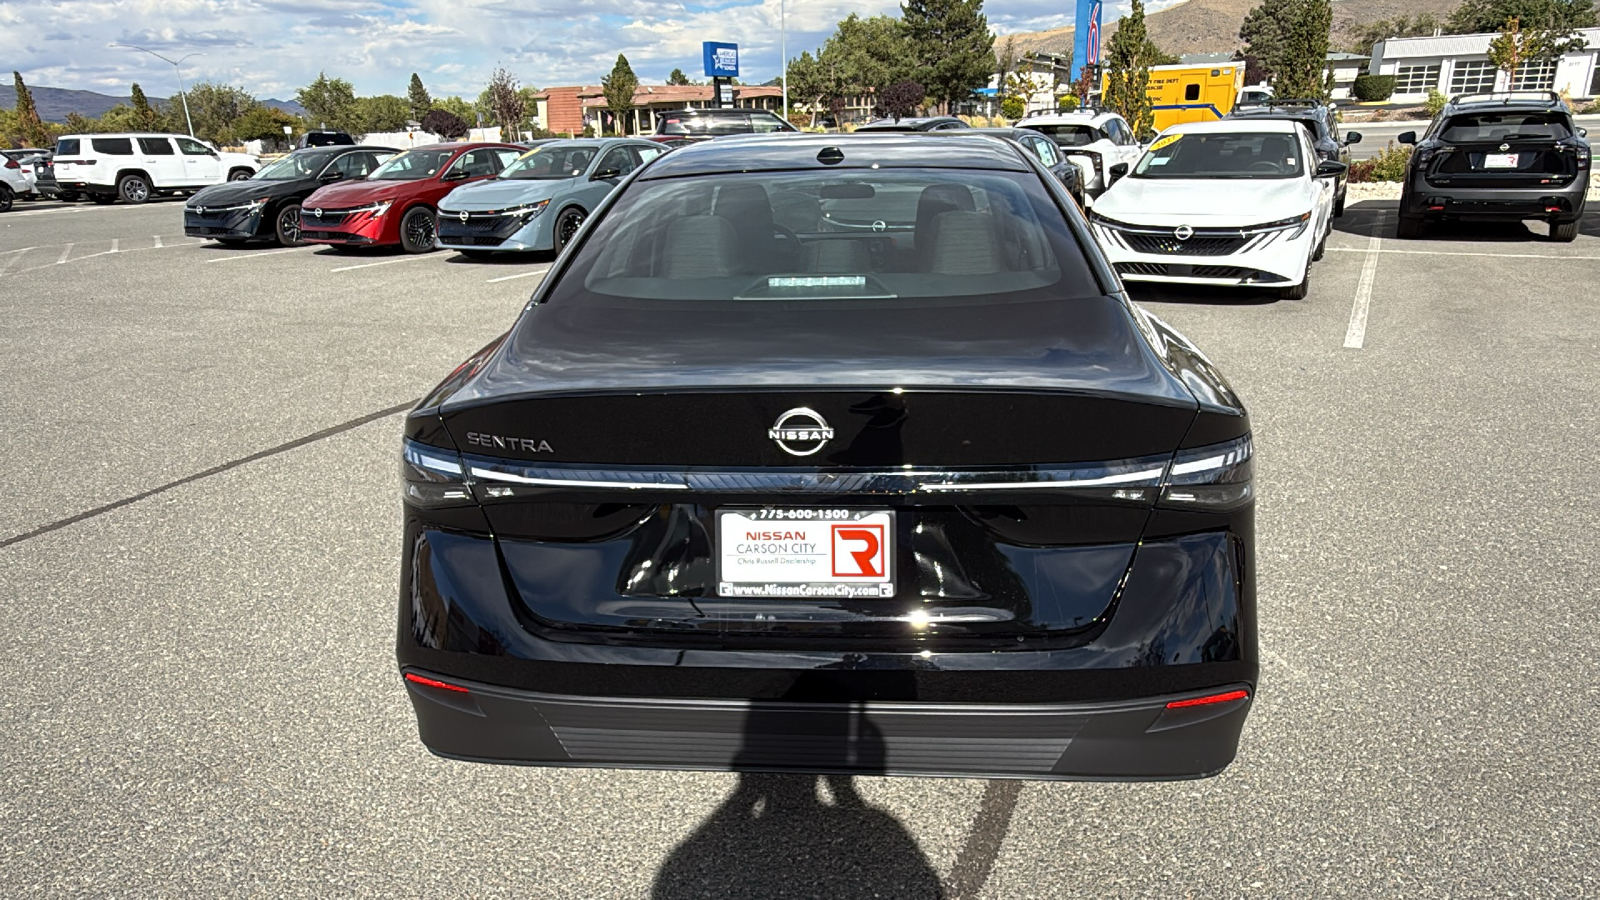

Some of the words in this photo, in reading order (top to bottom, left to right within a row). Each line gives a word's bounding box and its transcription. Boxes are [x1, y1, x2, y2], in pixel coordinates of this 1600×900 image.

[1087, 2, 1099, 65] 6
[768, 428, 834, 441] NISSAN
[466, 431, 554, 454] SENTRA
[759, 509, 849, 519] 775-600-1500
[746, 531, 806, 541] NISSAN
[736, 543, 788, 554] CARSON
[791, 543, 817, 553] CITY
[737, 557, 755, 565] Chris
[756, 557, 779, 565] Russell
[780, 557, 817, 566] Dealership
[733, 584, 879, 598] www.NissanCarsonCity.com
